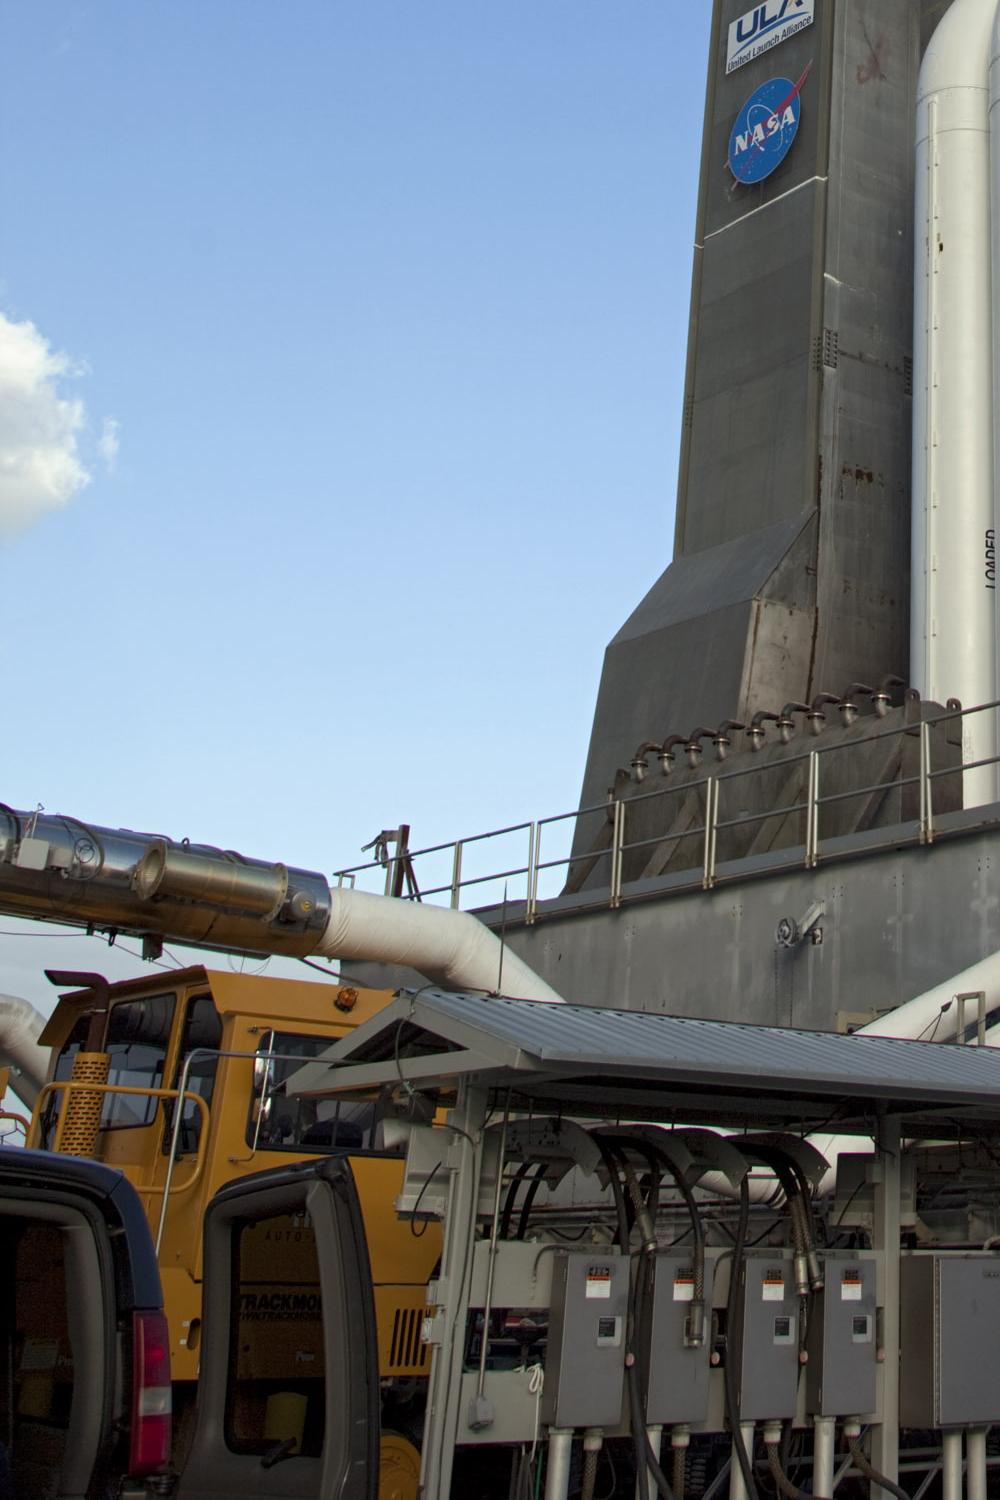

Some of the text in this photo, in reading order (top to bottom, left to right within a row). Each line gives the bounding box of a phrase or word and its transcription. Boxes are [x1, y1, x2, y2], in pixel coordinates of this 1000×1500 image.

[727, 14, 812, 72] United Launch Alliance
[734, 106, 796, 156] NASA
[265, 1230, 316, 1243] AUTO-
